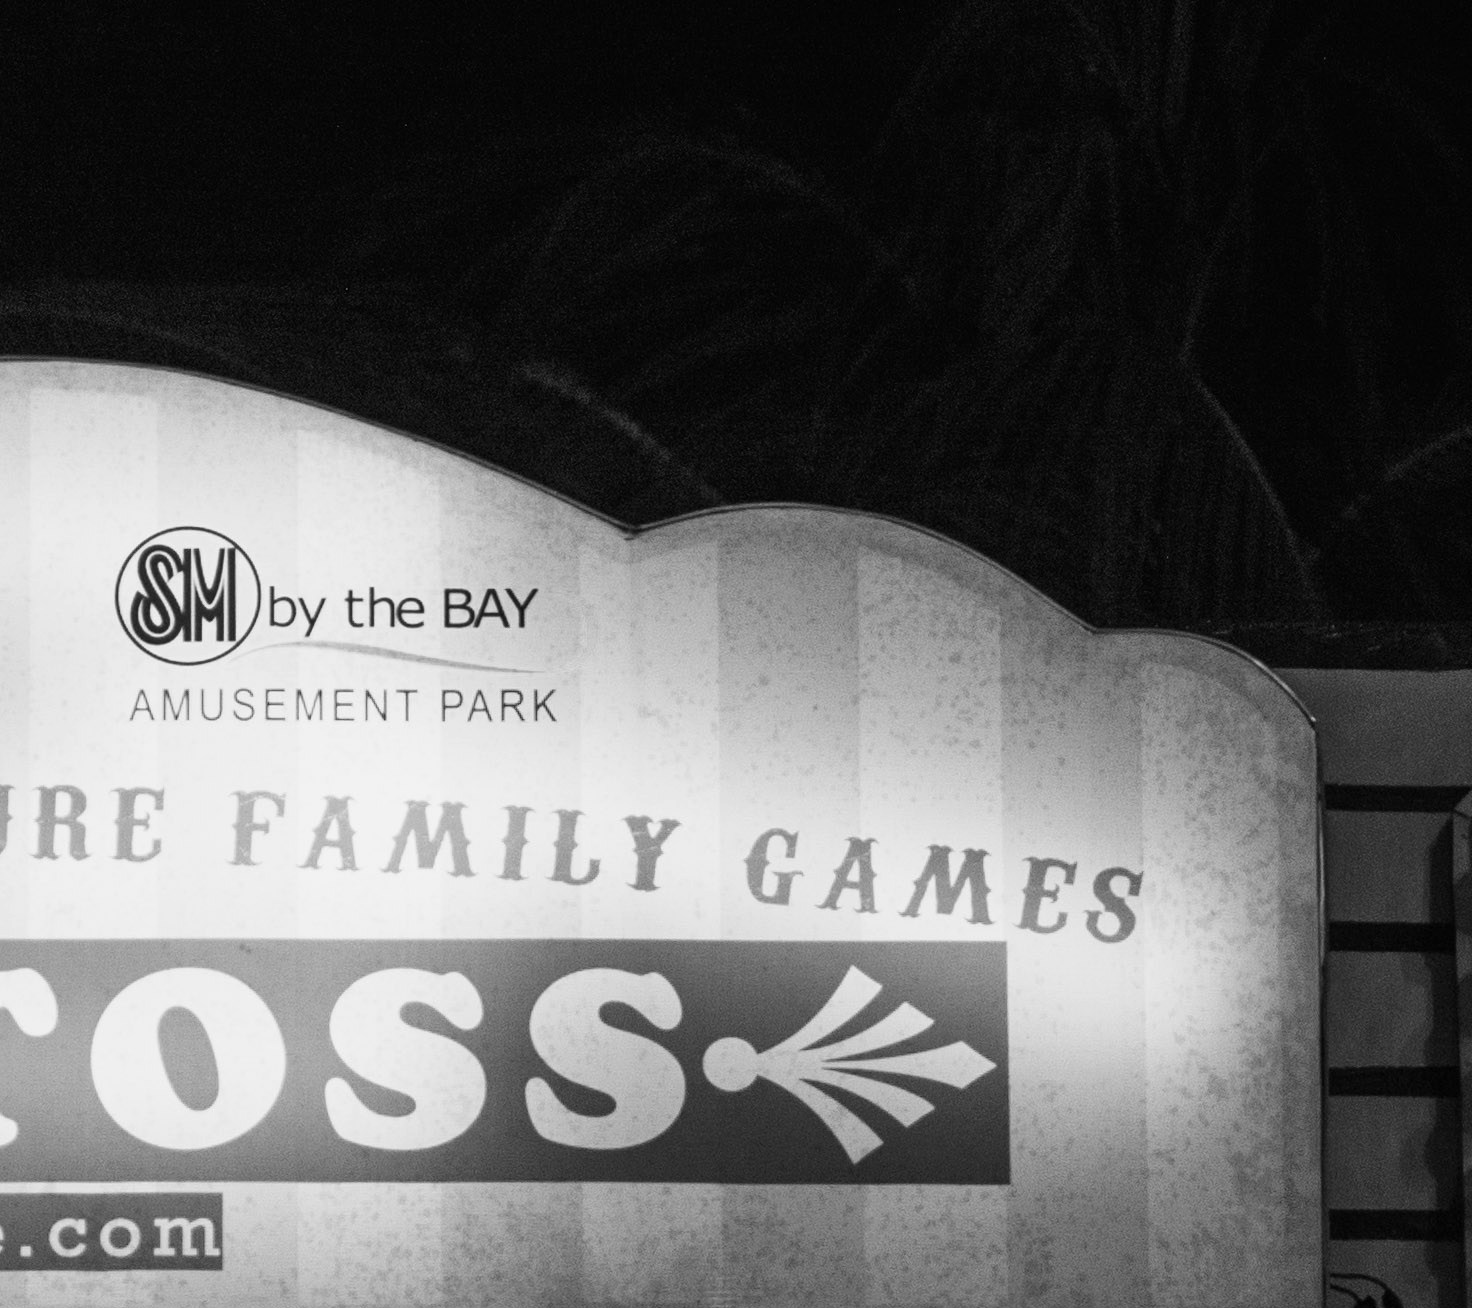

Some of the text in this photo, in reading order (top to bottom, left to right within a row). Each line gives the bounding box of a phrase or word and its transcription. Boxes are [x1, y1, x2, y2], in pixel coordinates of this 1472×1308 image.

[130, 544, 540, 646] SM by the BAY
[129, 688, 559, 722] AMUSEMENT PARK
[226, 790, 683, 893] FAMILY
[743, 827, 1144, 944] GAMES
